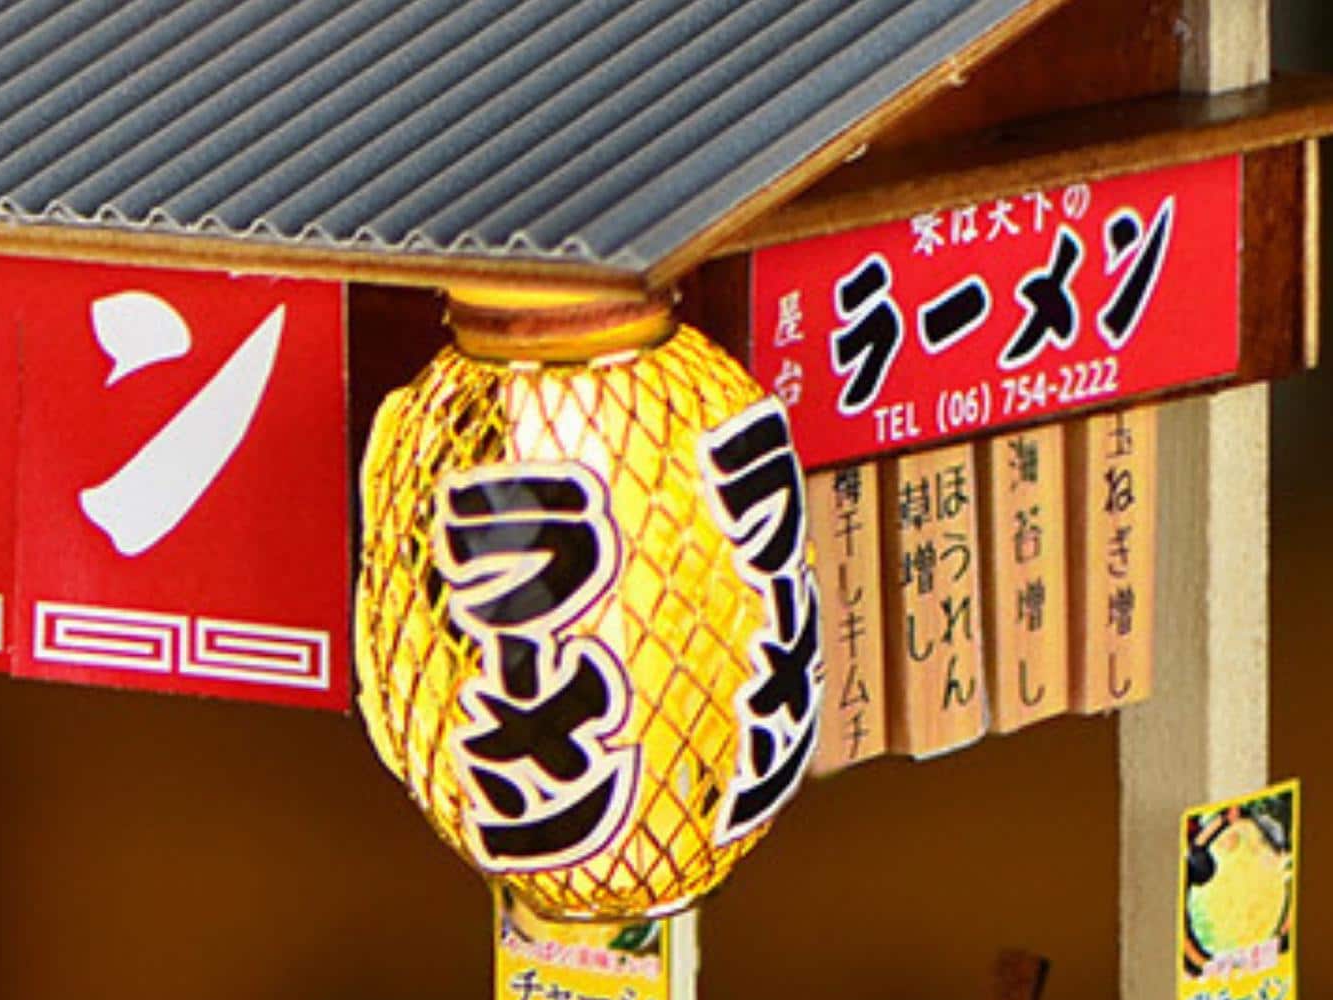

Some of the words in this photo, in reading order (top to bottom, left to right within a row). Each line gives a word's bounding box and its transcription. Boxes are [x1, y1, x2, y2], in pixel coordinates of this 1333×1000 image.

[831, 194, 1174, 416] ラーメン
[874, 407, 921, 443] TEL
[936, 388, 992, 436] (06)
[1001, 356, 1119, 413] 754-2222
[438, 464, 634, 870] ラーメン
[700, 400, 823, 845] ラーメン
